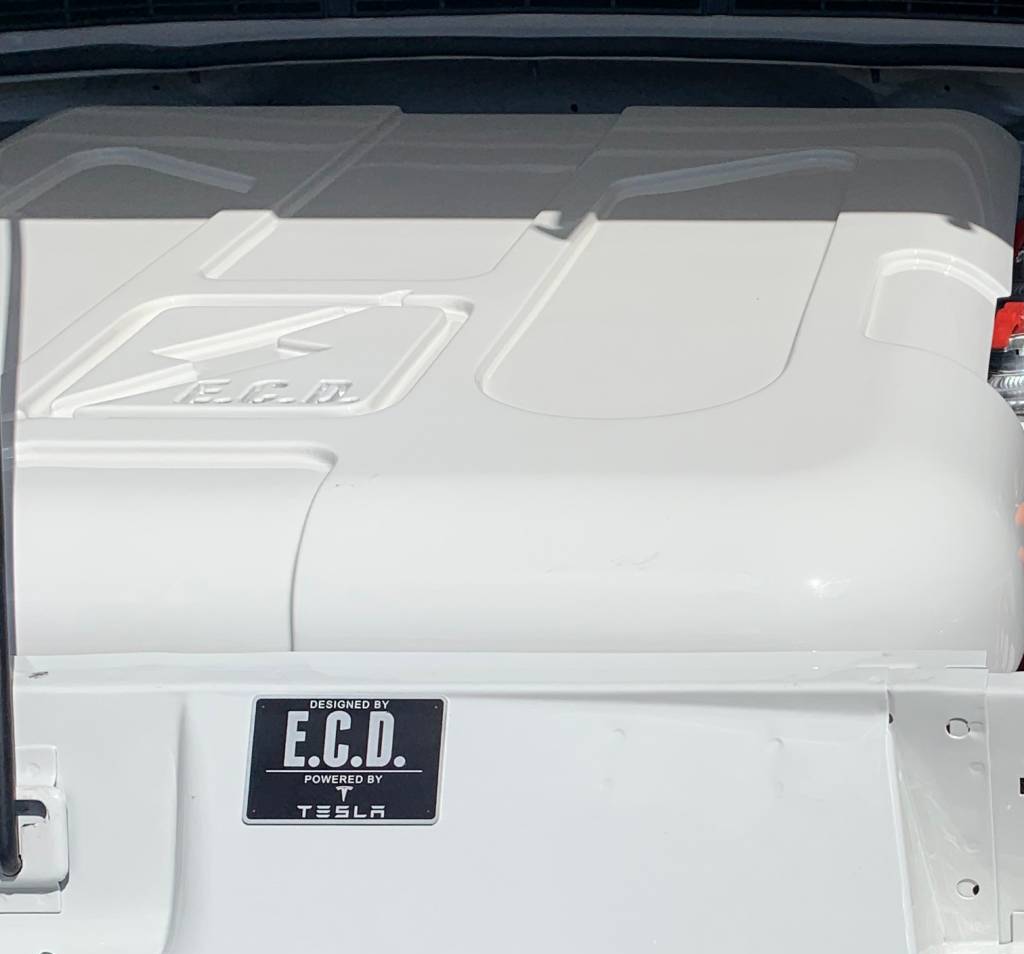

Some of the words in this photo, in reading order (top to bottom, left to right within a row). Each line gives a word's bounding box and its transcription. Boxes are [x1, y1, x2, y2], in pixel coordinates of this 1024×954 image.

[309, 700, 370, 709] DESIGNED
[374, 700, 390, 709] BY
[283, 710, 406, 768] E.C.D.
[304, 774, 364, 784] POWERED
[367, 774, 383, 784] BY
[296, 805, 386, 818] TESLA
